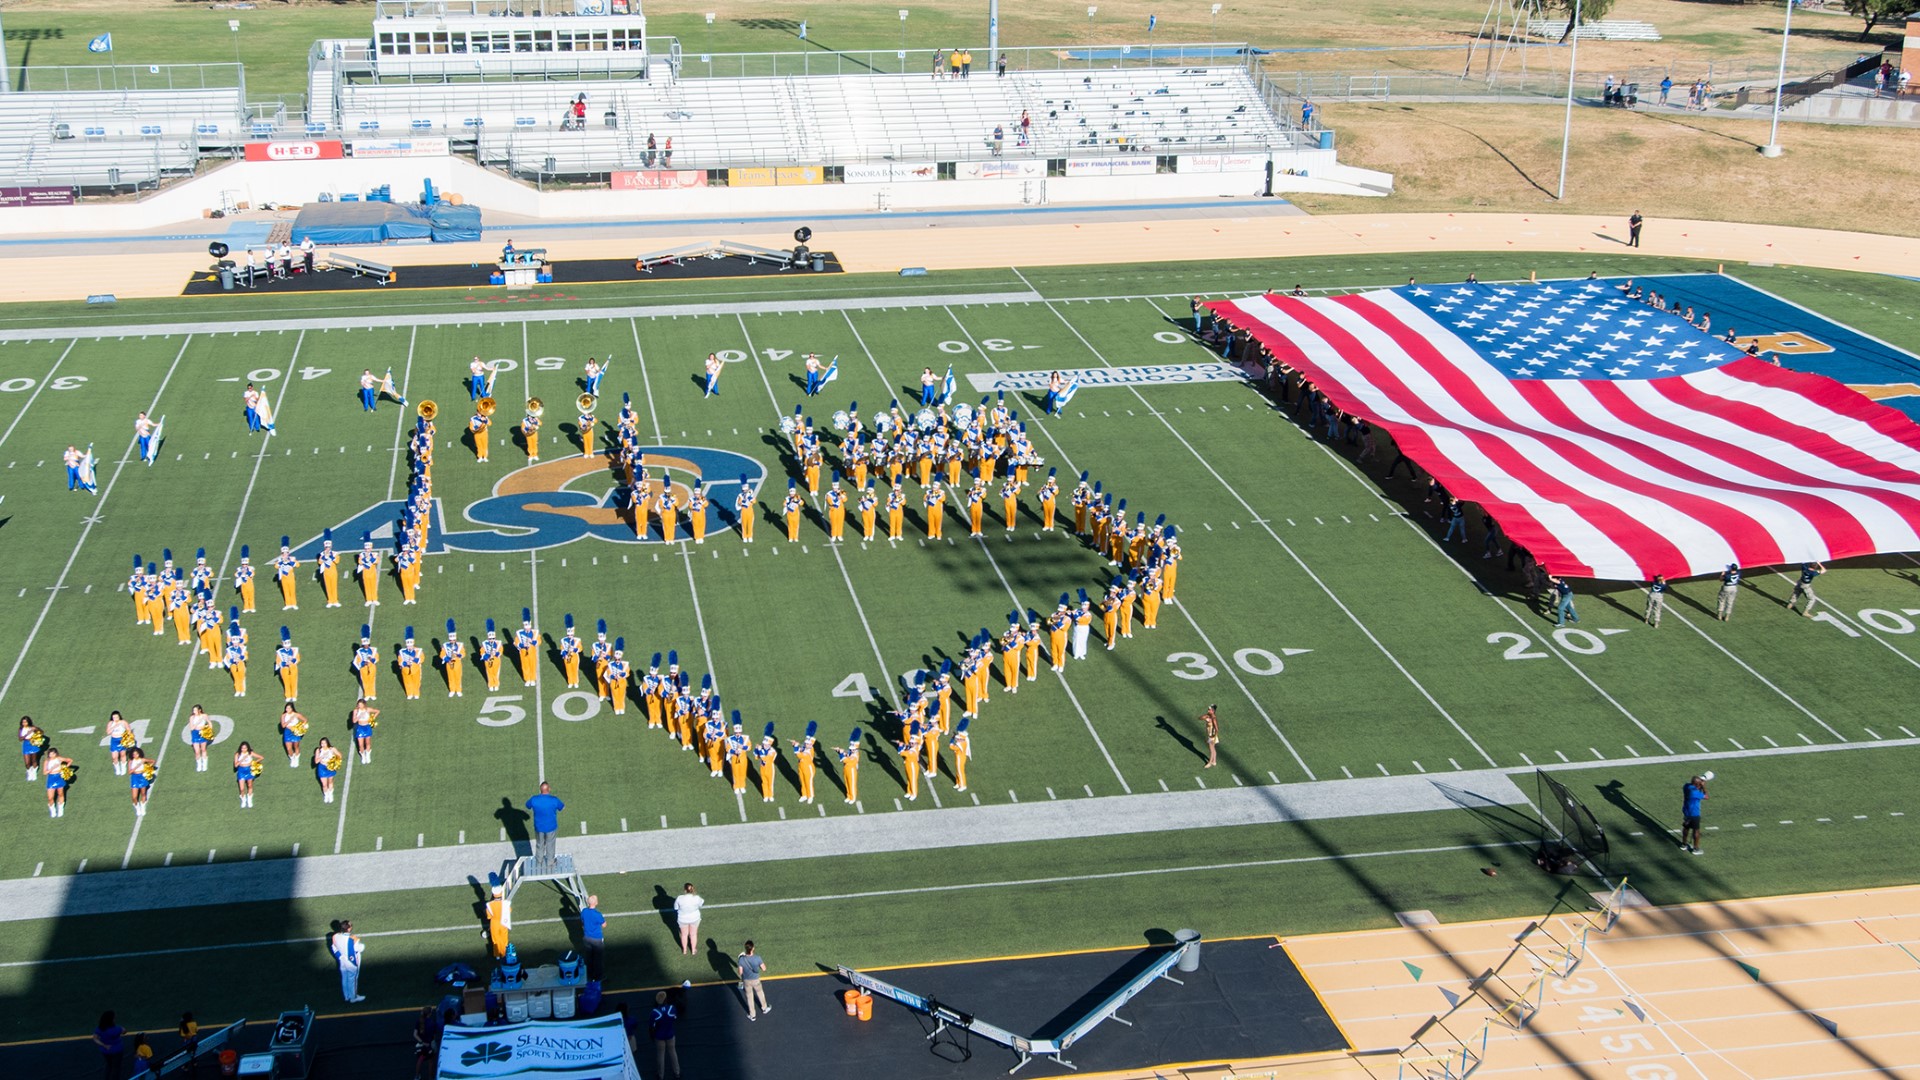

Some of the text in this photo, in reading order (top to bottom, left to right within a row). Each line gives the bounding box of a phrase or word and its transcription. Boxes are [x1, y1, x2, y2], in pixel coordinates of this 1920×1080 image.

[624, 177, 652, 186] BANK
[736, 169, 766, 180] Trans
[846, 168, 907, 178] SONORA BANK
[1006, 364, 1223, 381] Credit Unon
[1811, 608, 1916, 638] 10
[1486, 627, 1607, 660] 20
[1166, 647, 1284, 680] 30
[476, 691, 601, 727] 50
[516, 1034, 603, 1051] SHANNON
[516, 1050, 605, 1062] SPORTS MEDICINE
